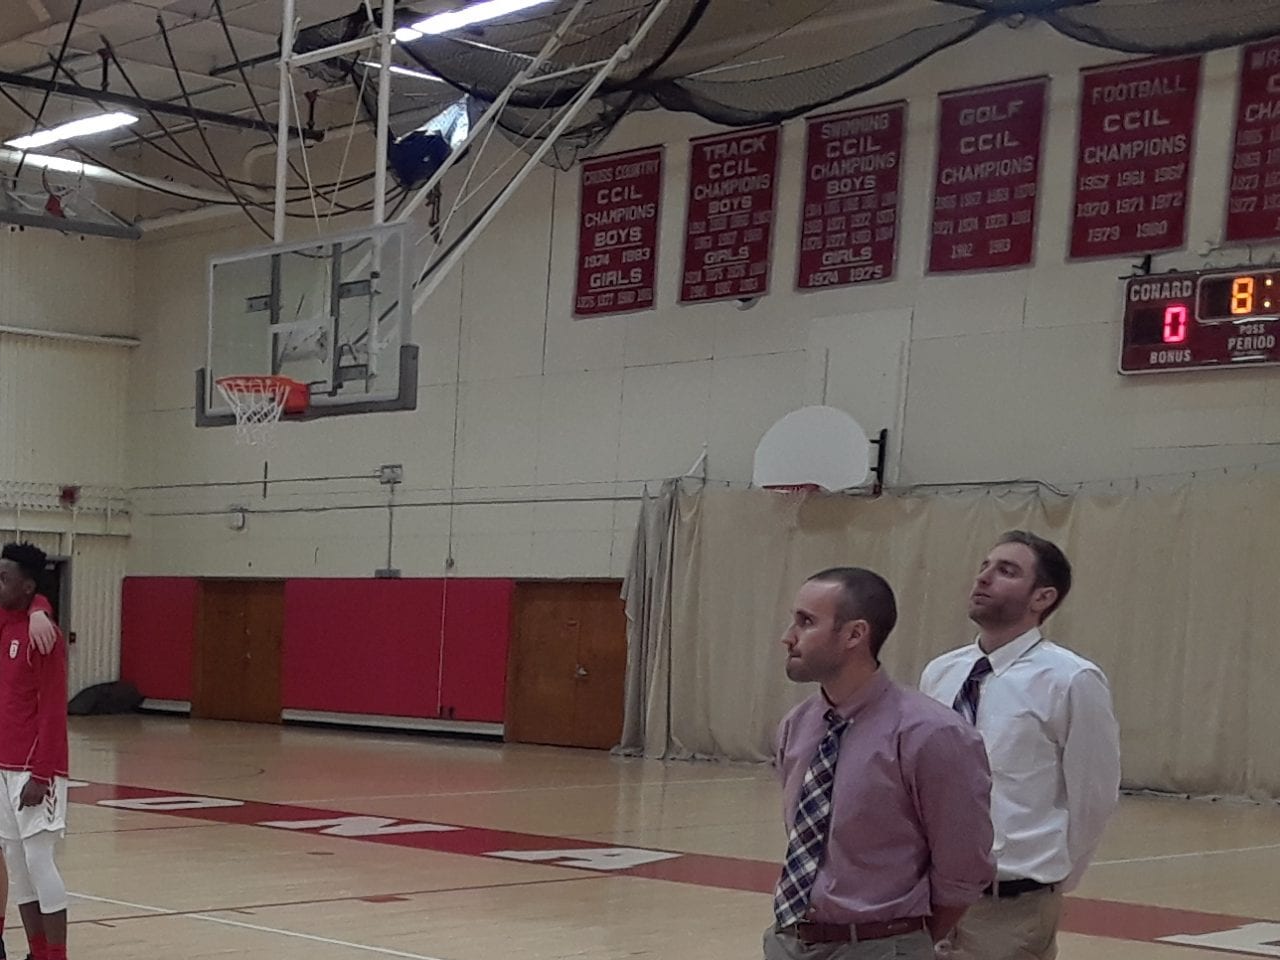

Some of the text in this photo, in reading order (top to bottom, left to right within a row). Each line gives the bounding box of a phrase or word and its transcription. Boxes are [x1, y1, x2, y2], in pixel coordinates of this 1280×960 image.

[1092, 74, 1187, 105] FOOTBALL
[959, 100, 1023, 127] GOLF
[1103, 108, 1170, 132] CCIL
[703, 136, 766, 161] TRACK
[826, 136, 881, 158] CCIL
[959, 130, 1020, 155] CCIL
[1083, 134, 1187, 164] CHAMPIONS
[616, 160, 659, 180] COUNTRY
[708, 158, 758, 179] CCIL
[811, 152, 896, 180] CHAMPIONS
[941, 155, 1035, 185] CHAMPIONS
[597, 185, 643, 204] CCIL
[694, 174, 770, 200] CHAMPIONS
[827, 175, 876, 194] BOYS
[708, 195, 752, 214] BOYS
[584, 203, 655, 228] CHAMPIONS
[594, 226, 642, 246] BOYS
[704, 246, 749, 264] GIRLS
[822, 247, 872, 266] GIRLS
[590, 268, 642, 288] GIRLS
[1130, 280, 1192, 301] CONARD
[1163, 306, 1186, 343] 0
[1239, 323, 1265, 335] POSS
[1227, 335, 1276, 350] PERIOD
[1150, 350, 1191, 364] BONUS
